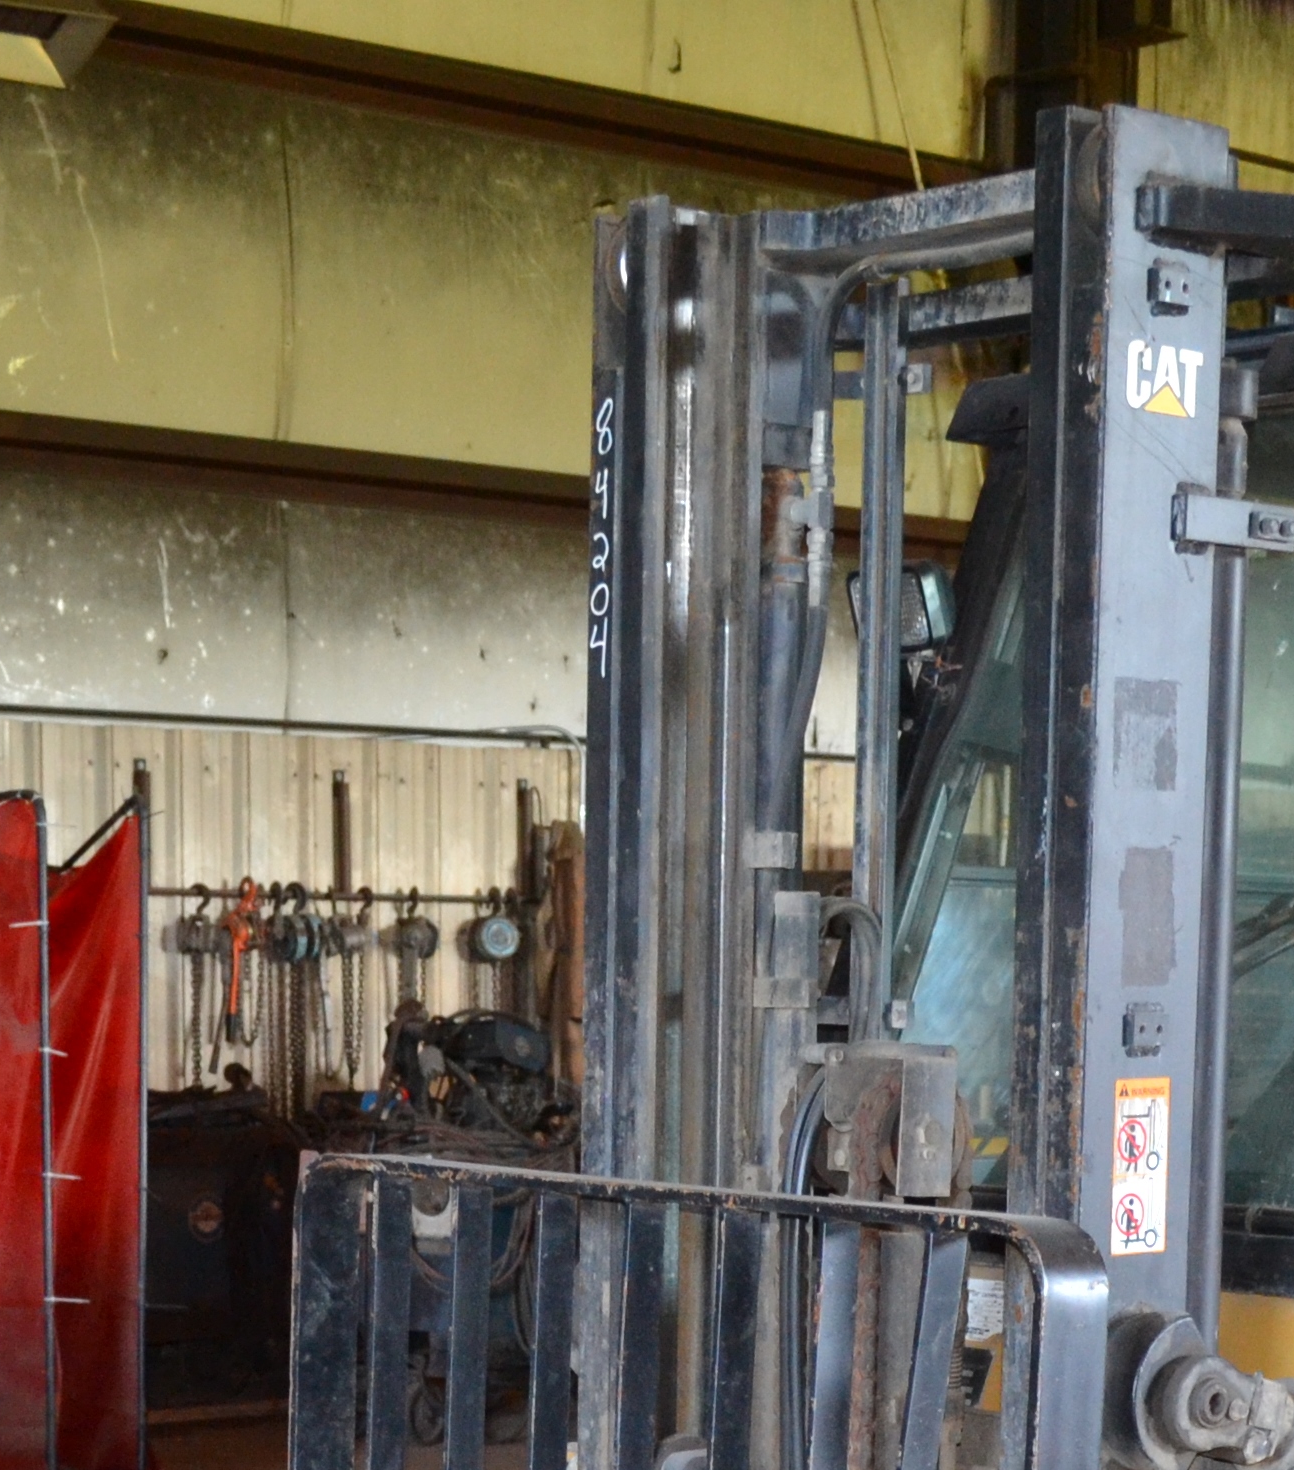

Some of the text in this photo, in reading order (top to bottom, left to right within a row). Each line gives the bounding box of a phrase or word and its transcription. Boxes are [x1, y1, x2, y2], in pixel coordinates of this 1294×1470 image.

[1125, 339, 1204, 419] CAT
[589, 397, 614, 679] 84204
[1131, 1085, 1165, 1096] WARNING
